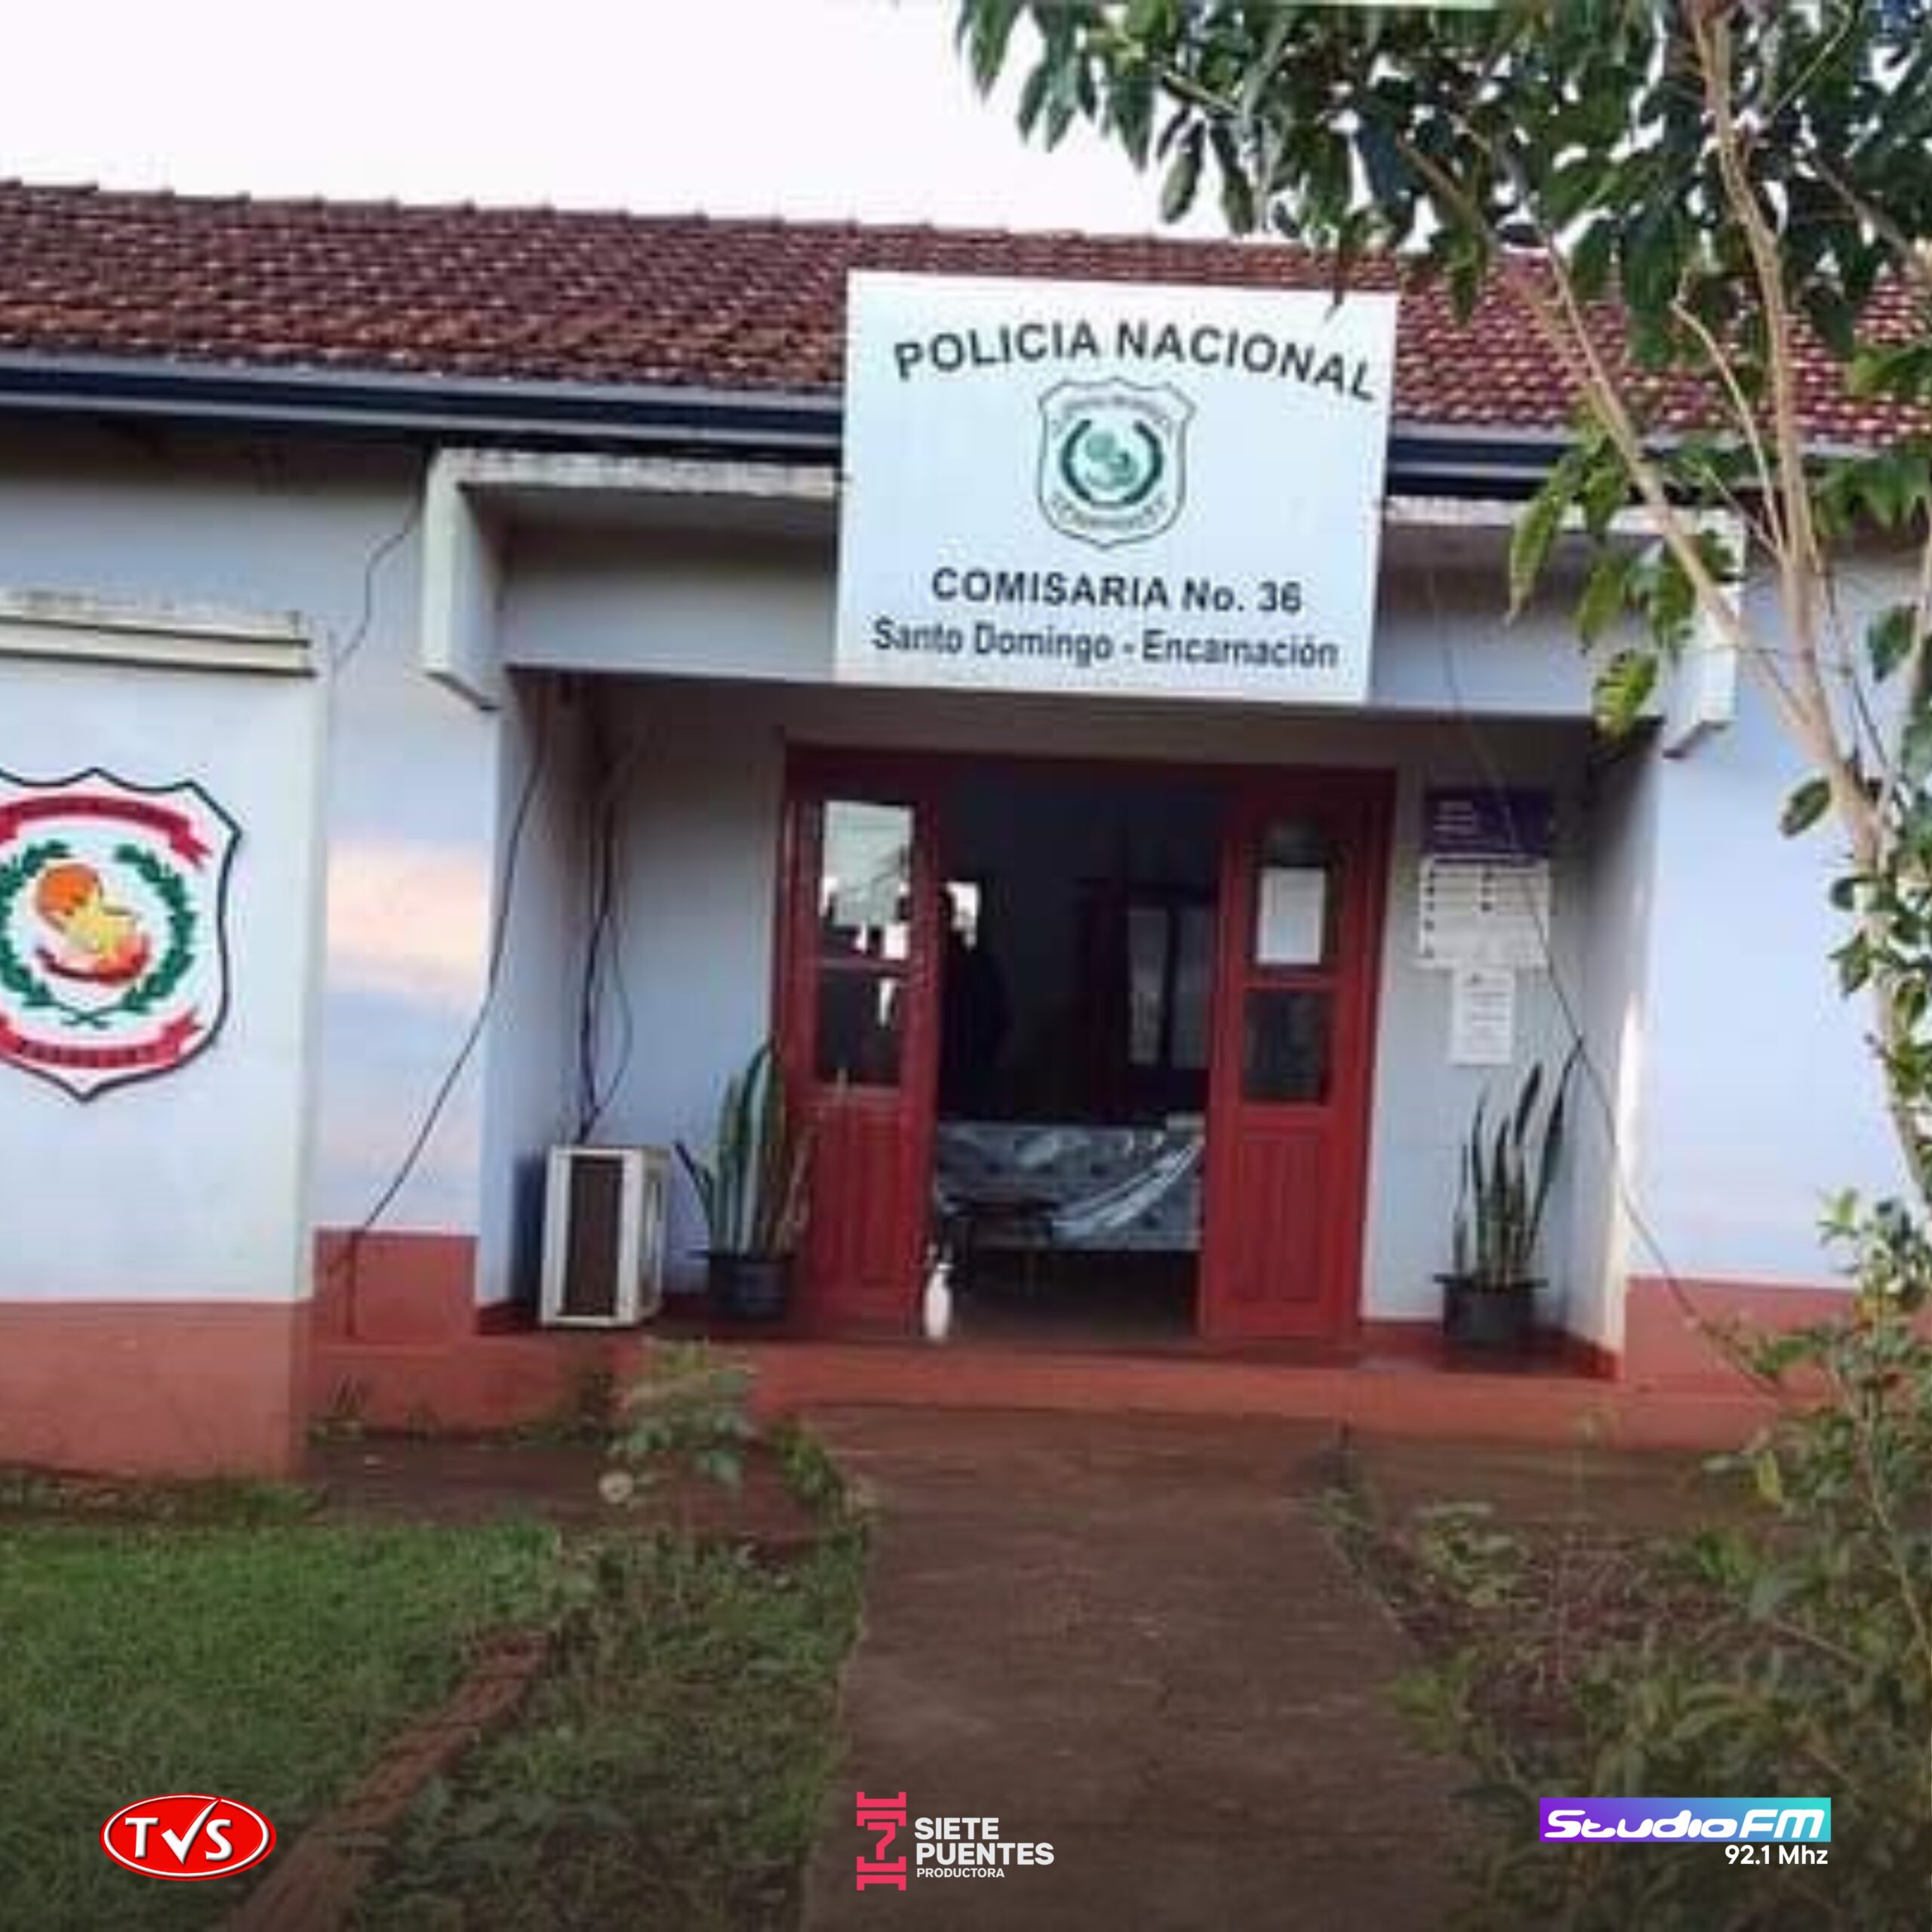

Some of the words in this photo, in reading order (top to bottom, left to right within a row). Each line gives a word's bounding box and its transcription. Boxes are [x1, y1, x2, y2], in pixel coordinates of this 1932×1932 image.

[894, 320, 1100, 381] POLICIA
[1116, 321, 1377, 402] NACIONAL
[931, 566, 1169, 612] COMISARIA
[1182, 580, 1245, 614] No.
[1257, 581, 1303, 616] 36
[872, 617, 964, 654] Santo
[974, 623, 1114, 668] Domingo
[1143, 629, 1340, 670] Encarnación
